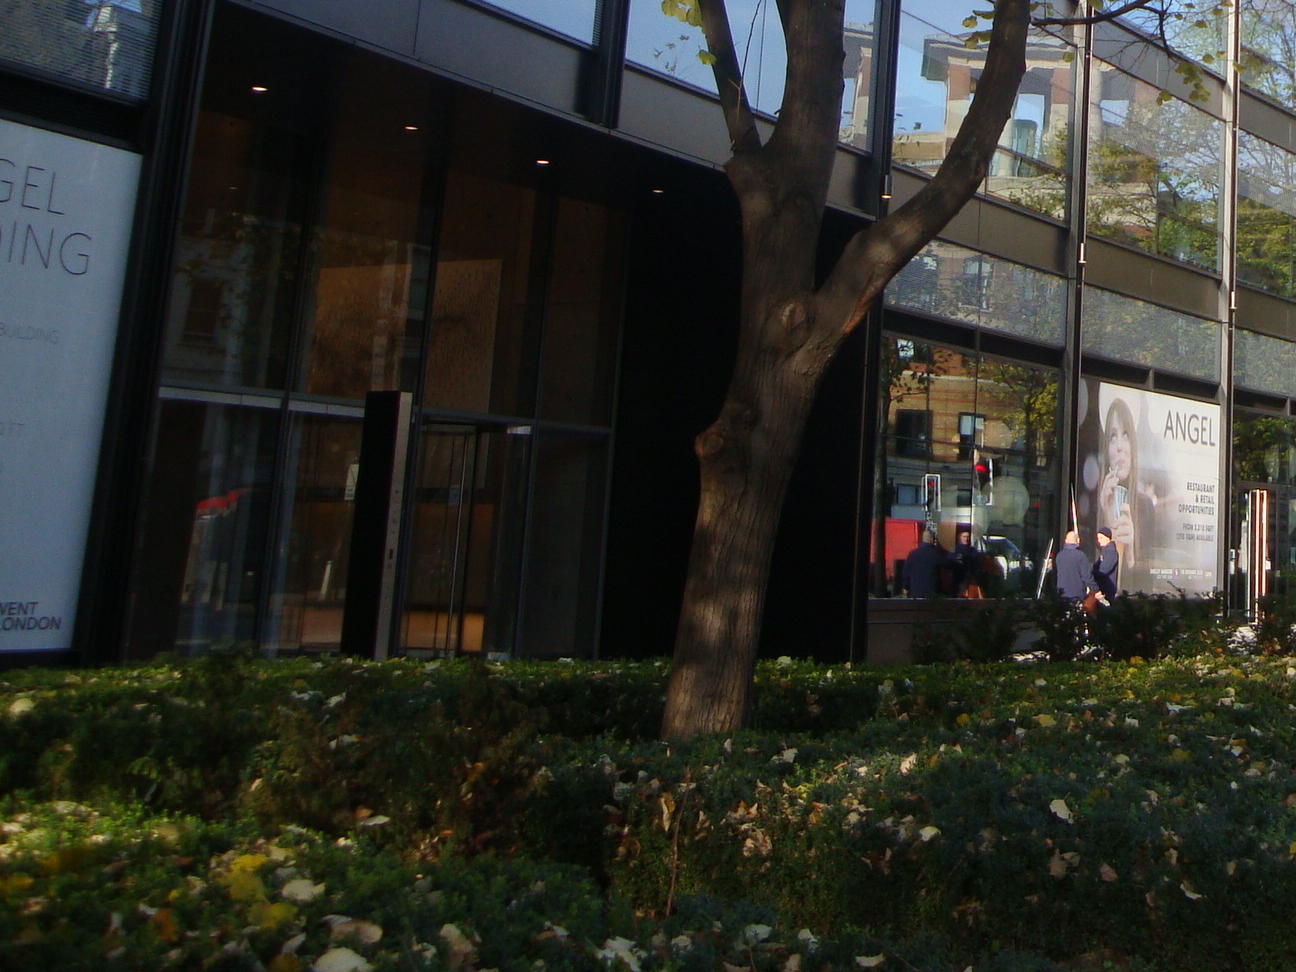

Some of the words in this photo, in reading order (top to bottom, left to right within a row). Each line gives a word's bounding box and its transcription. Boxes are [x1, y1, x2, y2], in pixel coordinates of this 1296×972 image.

[0, 221, 92, 276] ING
[1164, 409, 1216, 447] ANGEL
[1186, 481, 1215, 494] RESTAURANT
[1178, 504, 1215, 516] OPPORTUNITIES
[0, 616, 62, 631] ONDON
